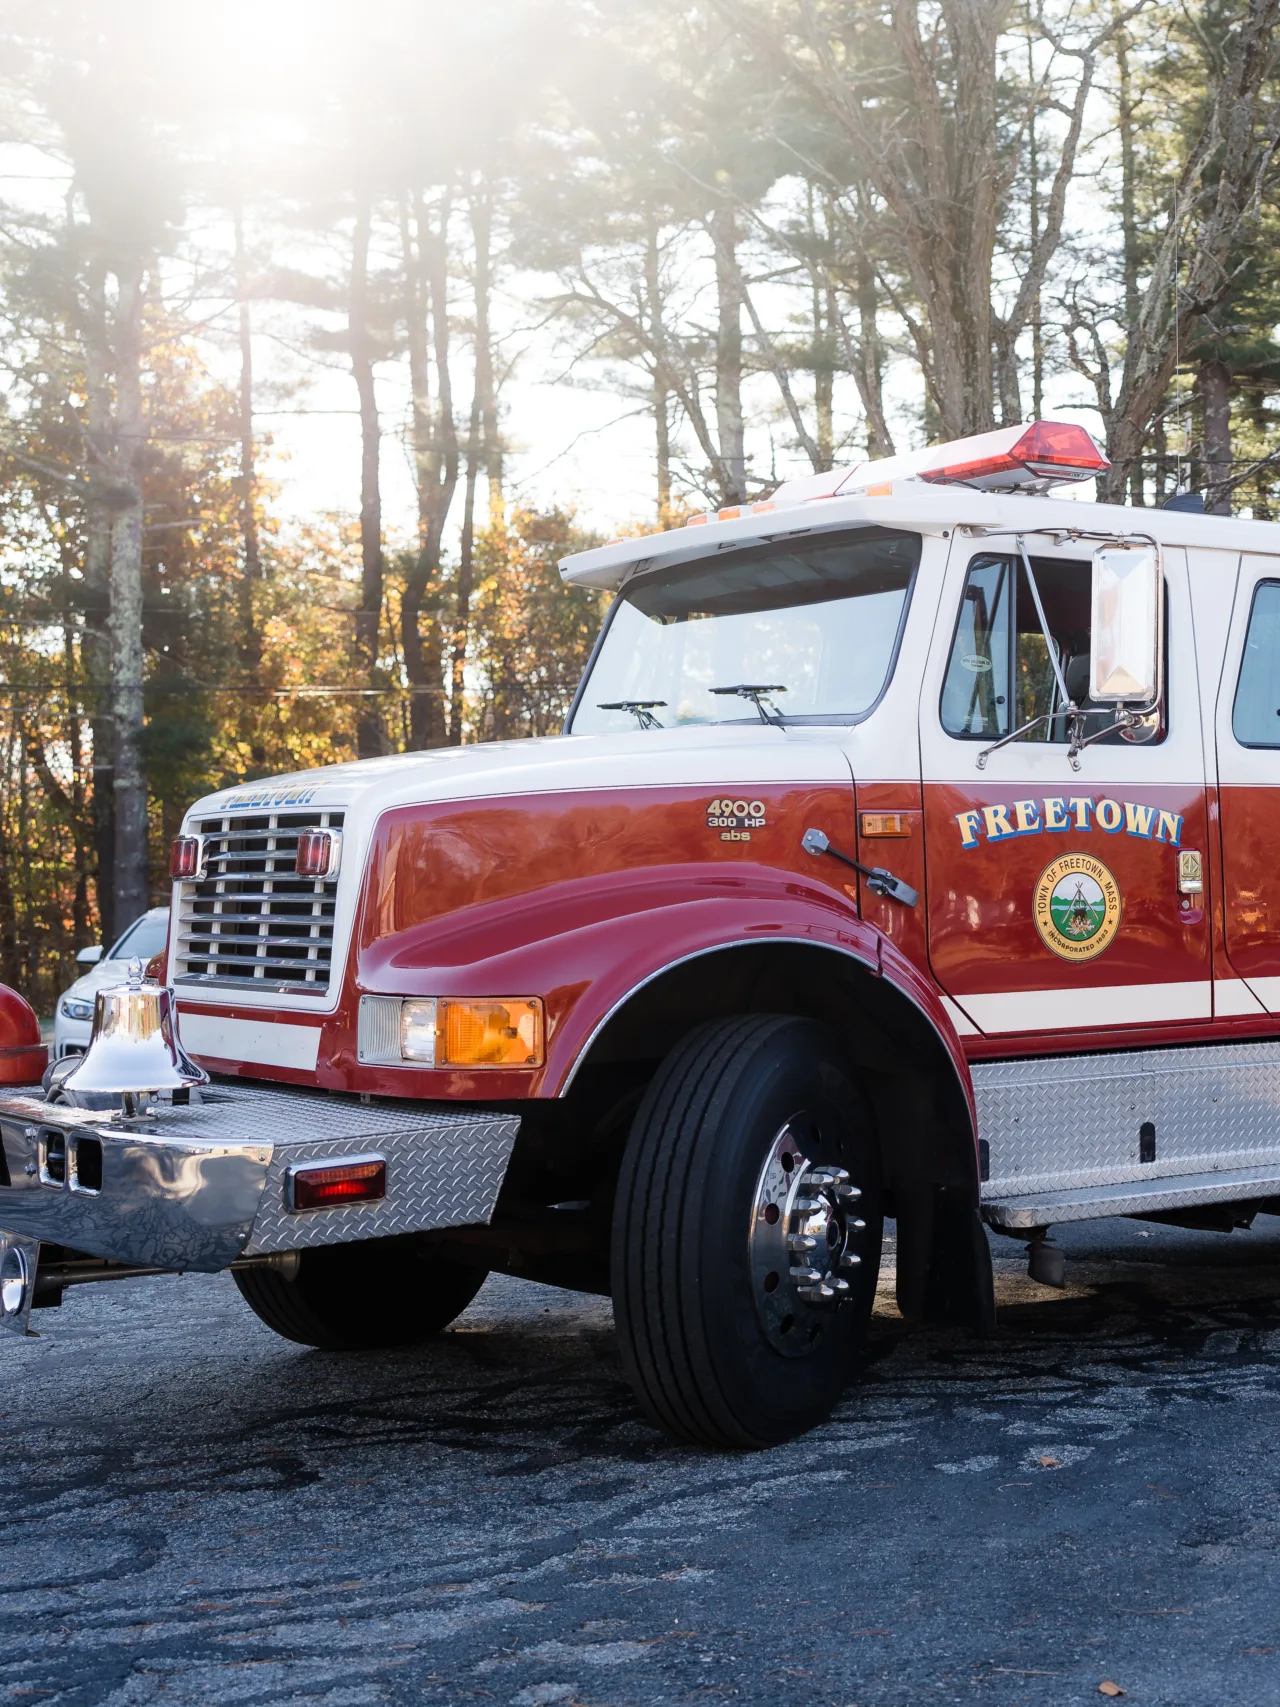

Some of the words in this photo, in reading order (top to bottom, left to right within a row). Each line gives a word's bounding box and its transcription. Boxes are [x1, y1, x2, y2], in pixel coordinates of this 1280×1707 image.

[706, 799, 766, 817] 4900
[708, 817, 737, 827] 300
[744, 818, 766, 827] HP
[955, 797, 1184, 849] FREETOWN
[720, 829, 751, 841] abs
[1037, 885, 1050, 915] TOWN
[1046, 868, 1057, 883] OF
[1058, 858, 1104, 881] FREETOWN,
[1104, 881, 1118, 914] MASS.
[1048, 930, 1095, 953] INCORPORATED
